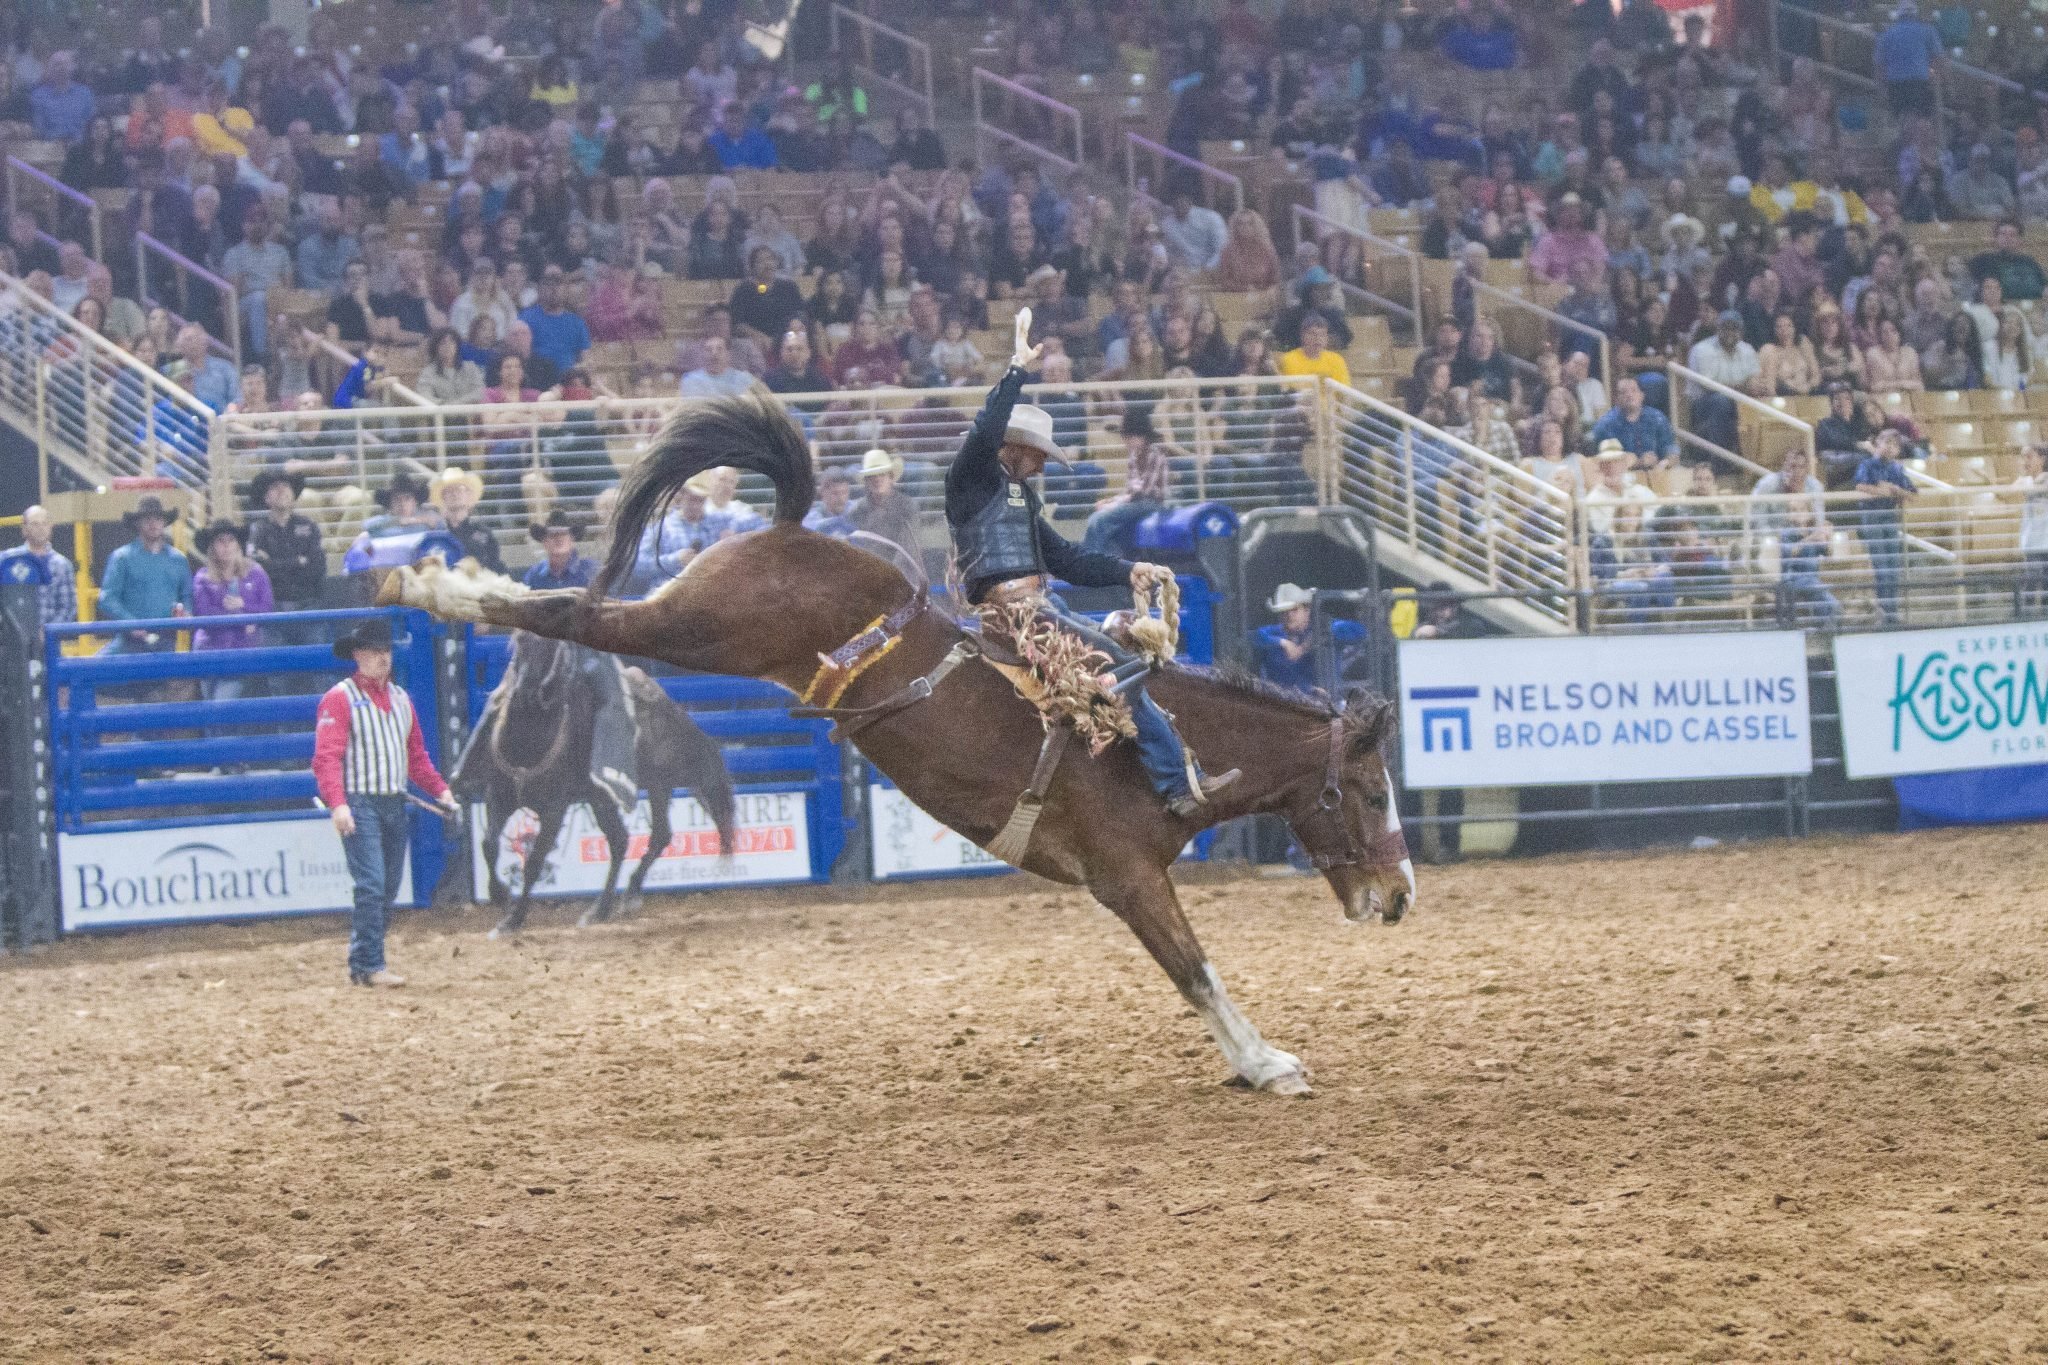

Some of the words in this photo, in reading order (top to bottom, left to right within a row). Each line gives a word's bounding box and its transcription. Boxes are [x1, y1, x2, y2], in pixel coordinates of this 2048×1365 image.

[1493, 682, 1638, 712] NELSON
[1654, 677, 1796, 707] MULLINS
[1495, 721, 1601, 749] BROAD
[1612, 718, 1673, 745] AND
[1681, 715, 1798, 743] CASSEL
[76, 850, 290, 910] Bouchard
